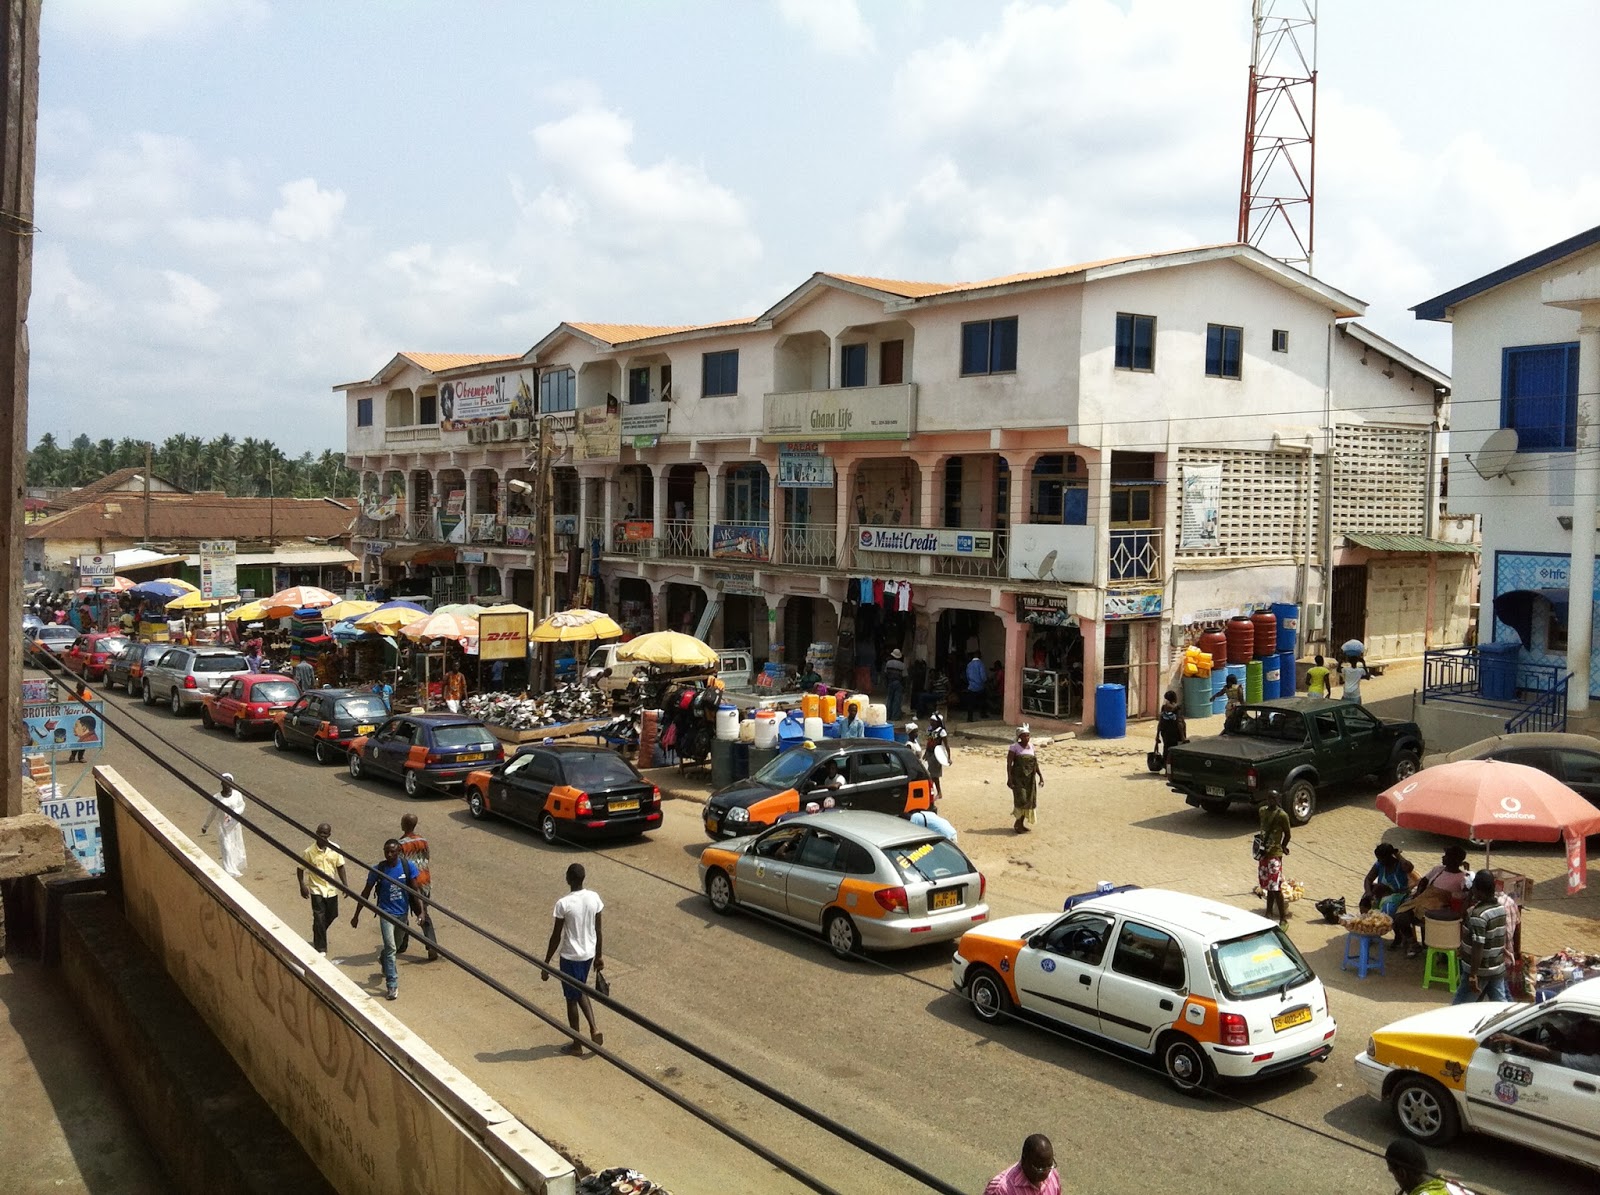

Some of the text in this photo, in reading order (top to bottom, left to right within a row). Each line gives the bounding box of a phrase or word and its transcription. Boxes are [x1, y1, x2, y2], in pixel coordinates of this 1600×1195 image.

[810, 408, 852, 431] Ghana Life
[1549, 569, 1566, 579] hfc
[487, 632, 521, 641] DHL
[1493, 812, 1536, 820] vodafone
